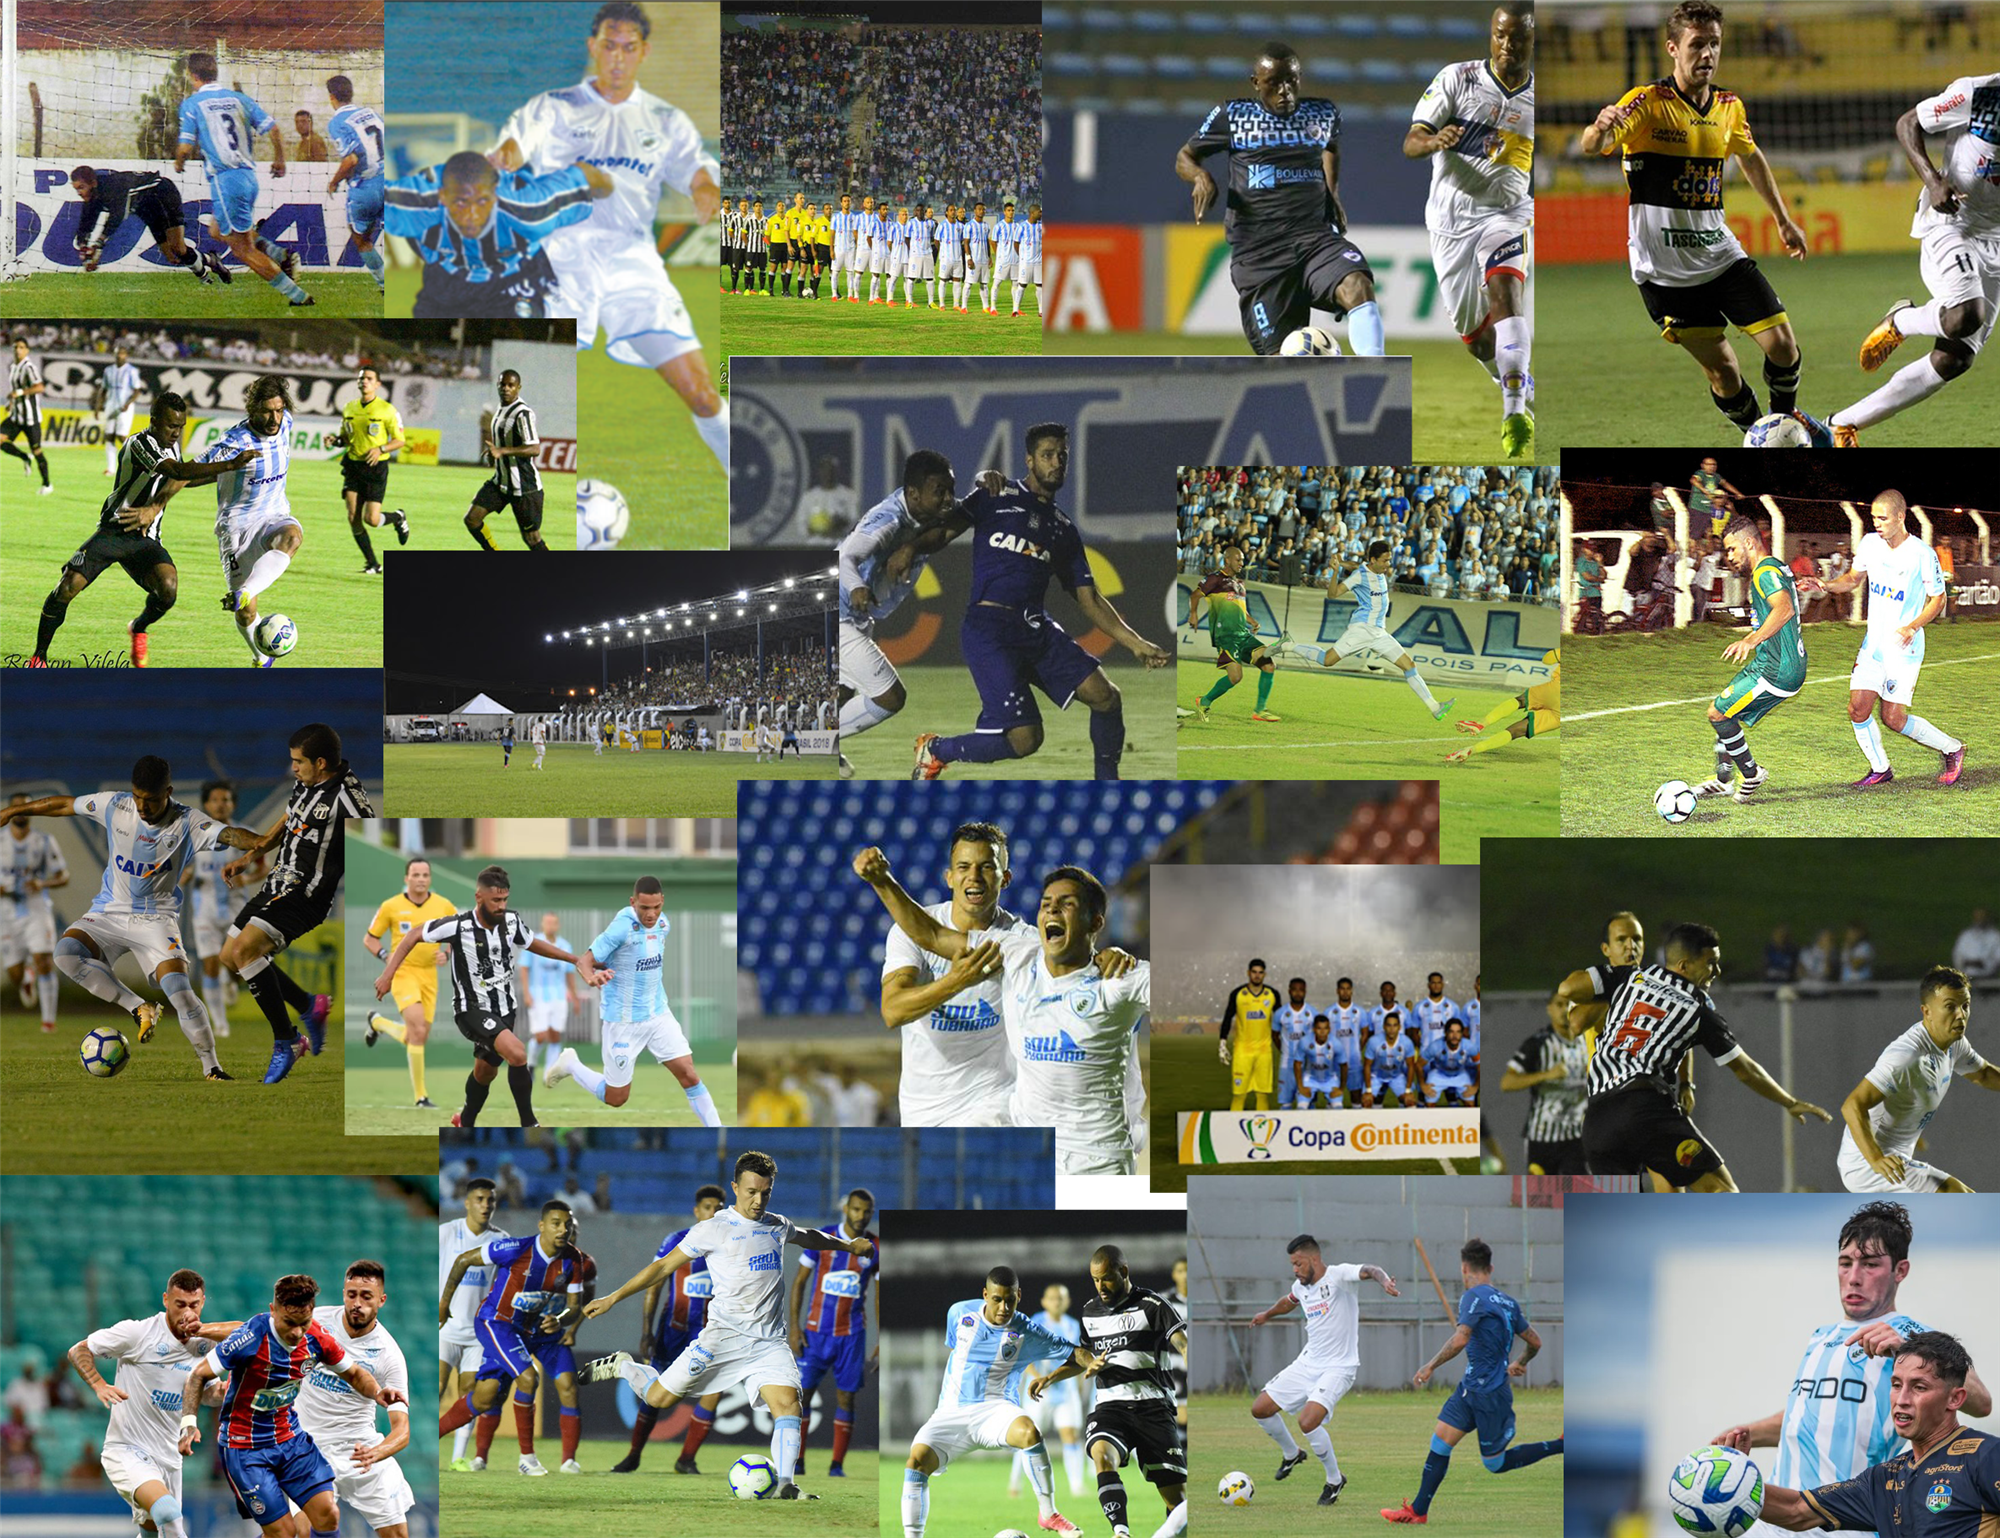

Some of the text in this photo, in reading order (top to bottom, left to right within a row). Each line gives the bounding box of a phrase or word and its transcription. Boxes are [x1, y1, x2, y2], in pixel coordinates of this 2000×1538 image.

[221, 113, 239, 150] 3
[1955, 253, 1974, 273] 11
[1253, 302, 1269, 329] 9
[989, 532, 1050, 563] CAIXA
[115, 854, 173, 878] CAIXA
[1288, 1122, 1480, 1152] Copa Continenta
